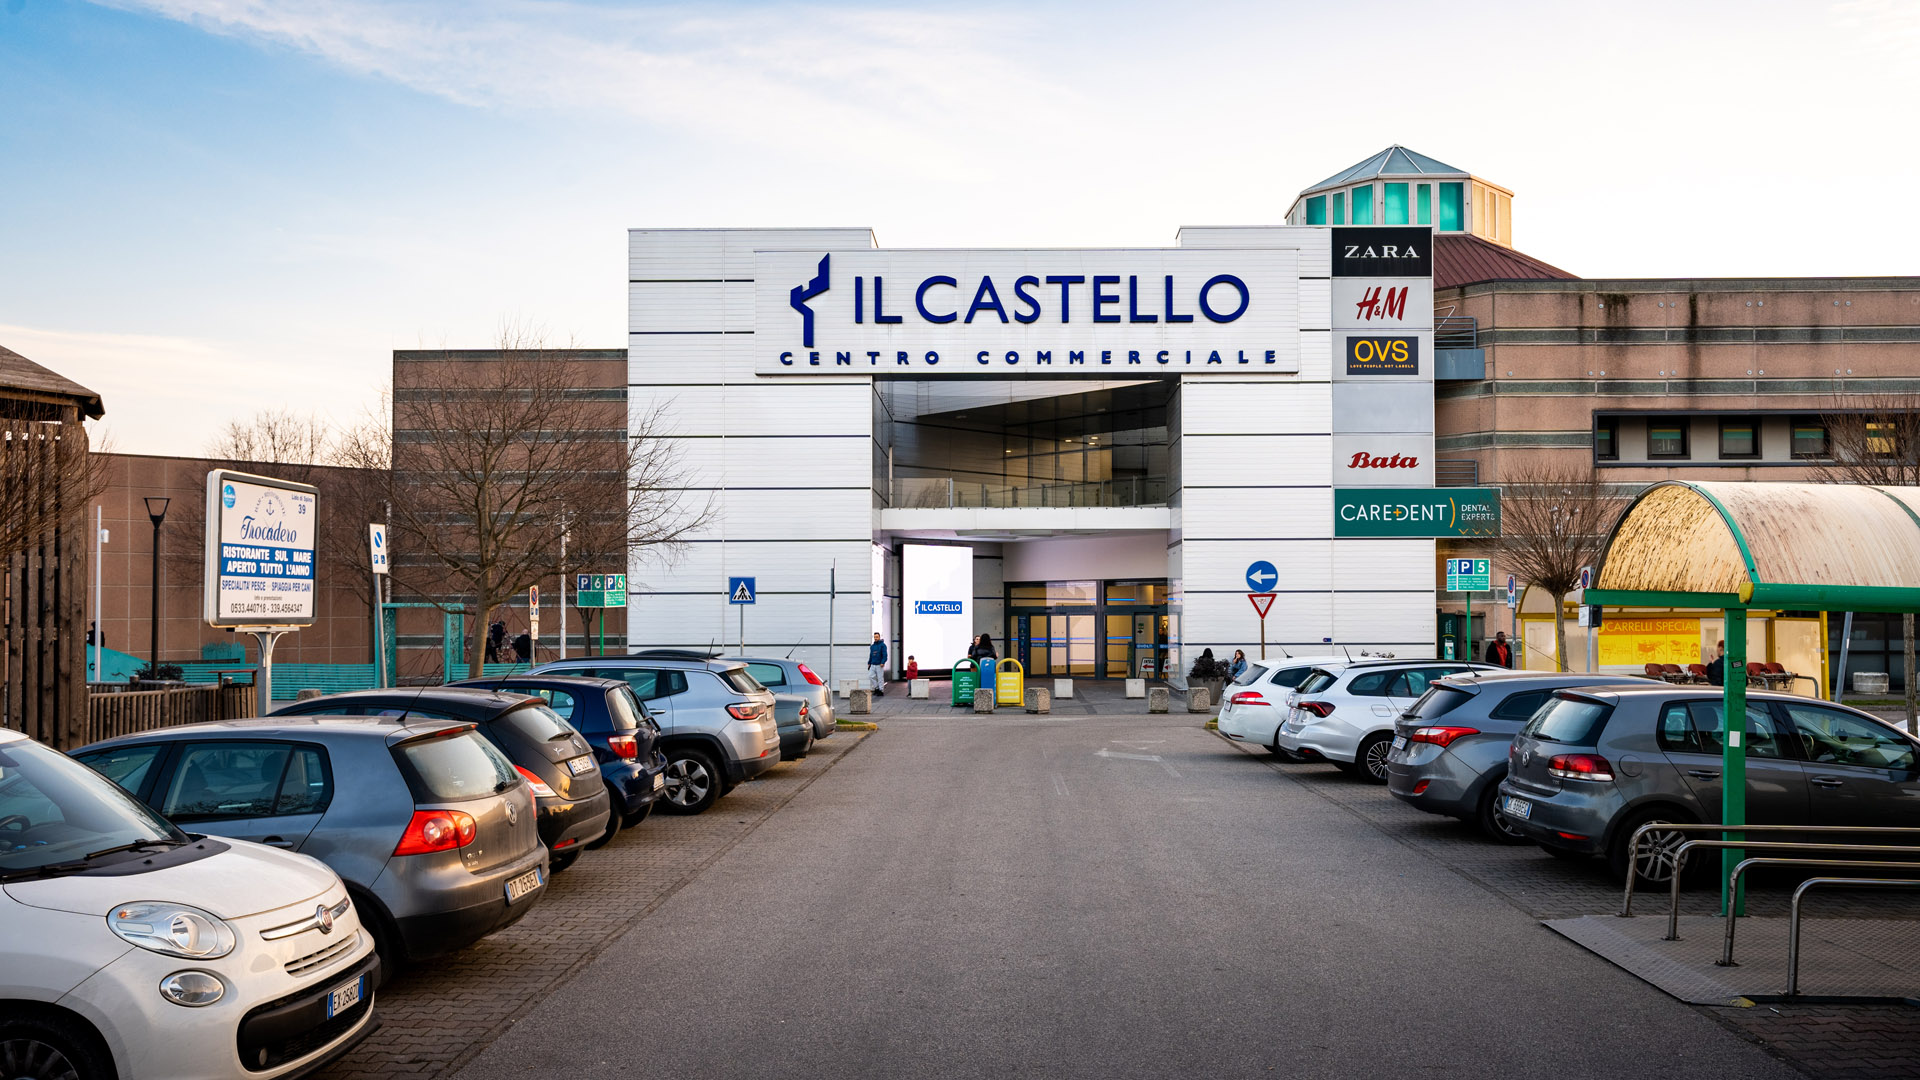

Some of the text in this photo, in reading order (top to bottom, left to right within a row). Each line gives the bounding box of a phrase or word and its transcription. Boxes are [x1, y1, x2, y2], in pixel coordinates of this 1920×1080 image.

[1344, 245, 1420, 259] ZARA
[855, 274, 1250, 325] IL CASTELLO
[1356, 286, 1408, 321] H&M
[1354, 340, 1409, 362] OVS
[780, 350, 1276, 366] CENTRO COMMERCIALE
[1347, 451, 1420, 469] Bata
[298, 504, 306, 514] 39
[1461, 504, 1491, 512] DENTAL
[1461, 513, 1496, 521] EXPERTS
[240, 515, 297, 543] Trocadero
[223, 546, 311, 564] RISTORANTE SUL MARE
[226, 560, 310, 576] APERTO TUTTO L'ANNO
[1461, 561, 1486, 573] P 5
[251, 581, 266, 591] PESCE
[271, 581, 292, 592] SPIAGGIA
[292, 582, 301, 592] PER
[301, 583, 311, 593] CANI
[581, 577, 601, 589] P 6
[607, 577, 623, 589] P 6
[921, 603, 961, 612] IL CASTELLO
[1606, 621, 1652, 632] CARRELLI
